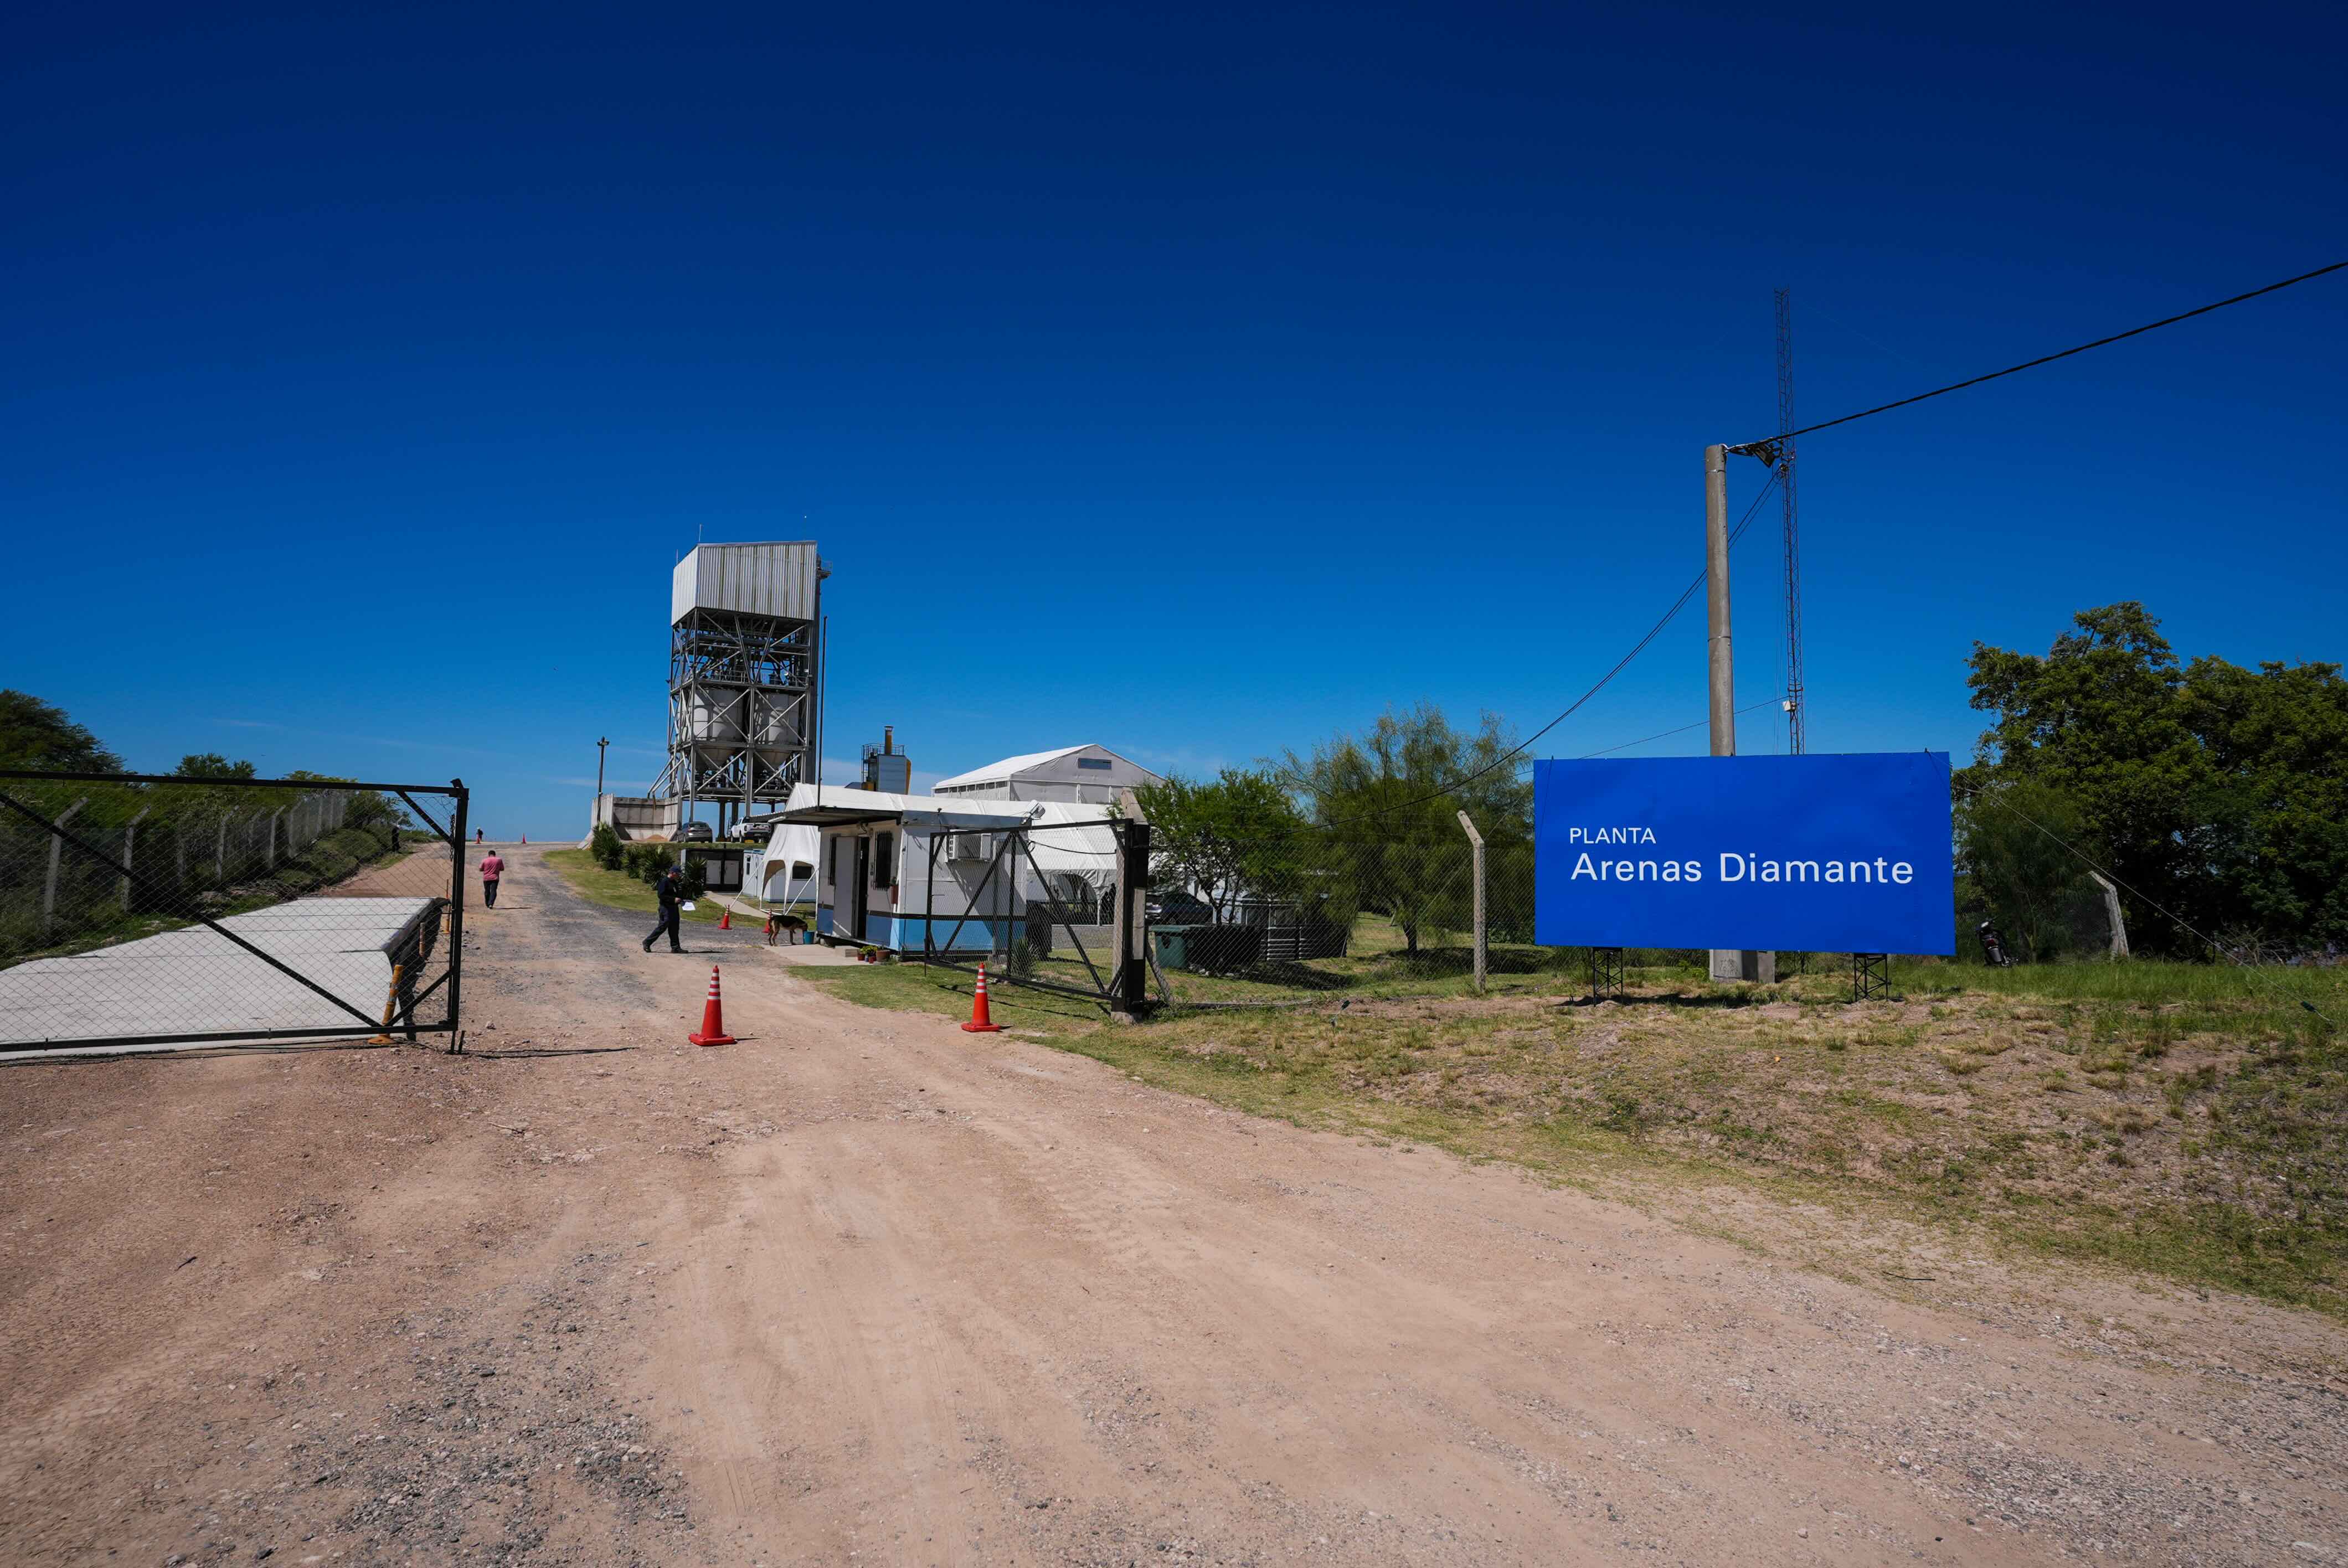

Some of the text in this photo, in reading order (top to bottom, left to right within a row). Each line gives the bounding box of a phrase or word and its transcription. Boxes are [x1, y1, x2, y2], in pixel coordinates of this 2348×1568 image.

[1569, 827, 1656, 844] PLANTA
[1571, 852, 1913, 884] Arenas Diamante
